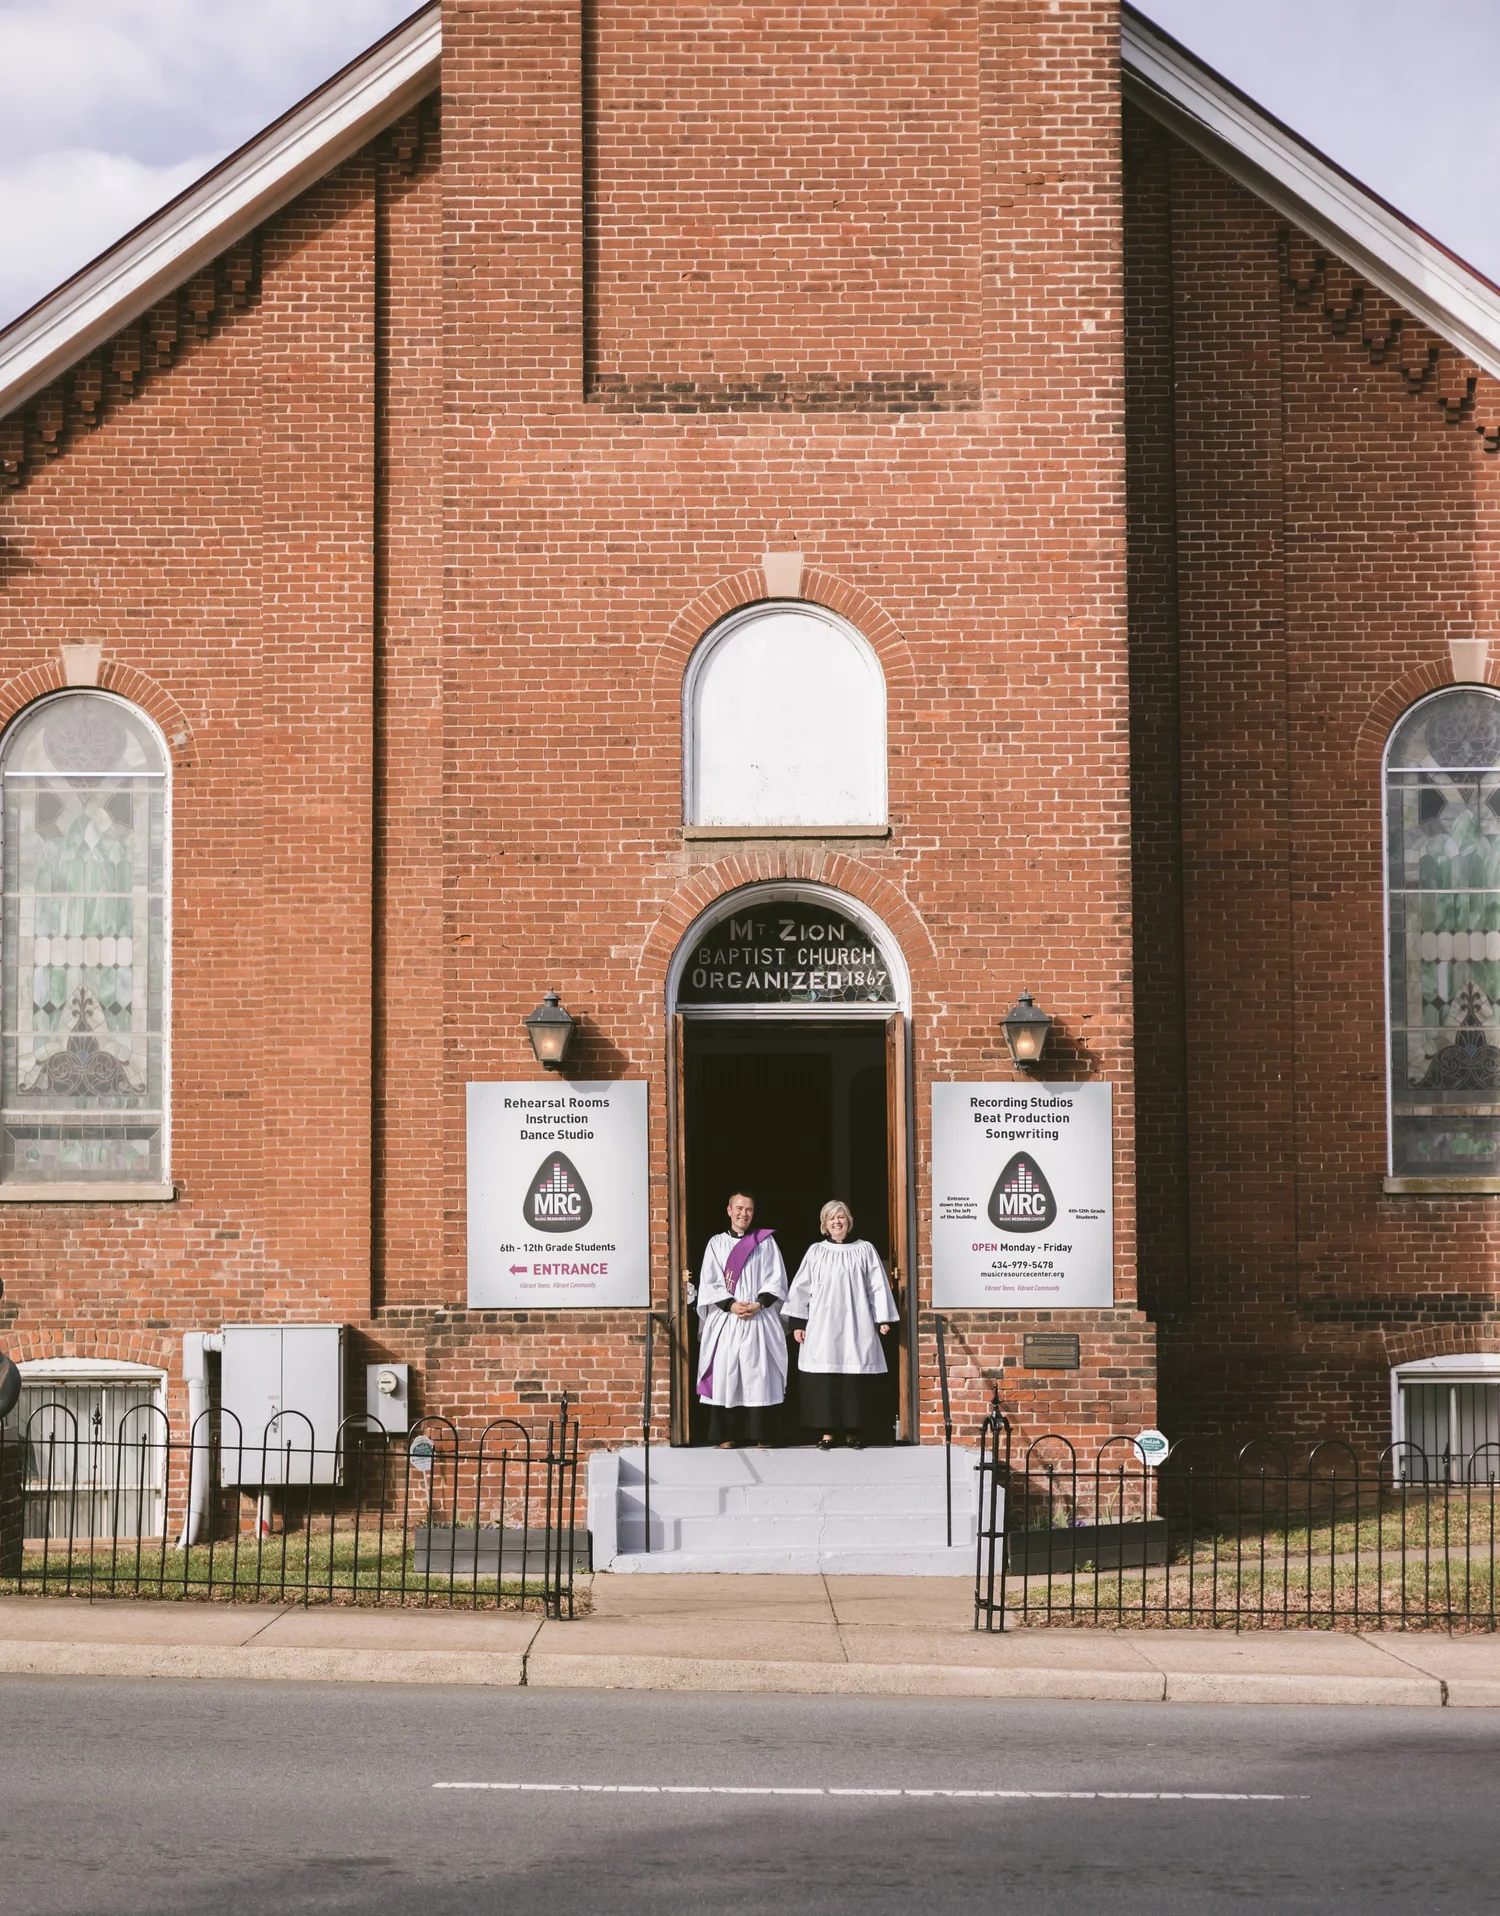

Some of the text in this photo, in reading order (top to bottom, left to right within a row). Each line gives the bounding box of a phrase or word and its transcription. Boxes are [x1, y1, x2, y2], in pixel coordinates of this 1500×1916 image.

[778, 919, 845, 941] ZION
[700, 948, 875, 965] BAPTIST CHURCH
[692, 968, 887, 989] ORGANIZED 1867
[504, 1097, 610, 1108] Rehearsal Rooms
[970, 1096, 1074, 1109] Recording Studios
[525, 1113, 589, 1123] Instruction
[974, 1112, 1070, 1122] Beat Production
[520, 1129, 594, 1139] Dance Studio
[985, 1128, 1059, 1140] Songwriting
[535, 1193, 581, 1214] MRC
[1000, 1194, 1045, 1214] MRC
[499, 1243, 515, 1253] 6th
[523, 1243, 544, 1252] 12th
[545, 1243, 574, 1252] Grade
[574, 1242, 616, 1252] Students
[971, 1243, 998, 1252] OPEN
[1000, 1243, 1036, 1253] Monday
[1043, 1243, 1073, 1253] Friday
[533, 1262, 608, 1275] ENTRANCE
[991, 1260, 1054, 1269] 434-979-5478
[980, 1271, 1065, 1279] musicresourcecenter.org
